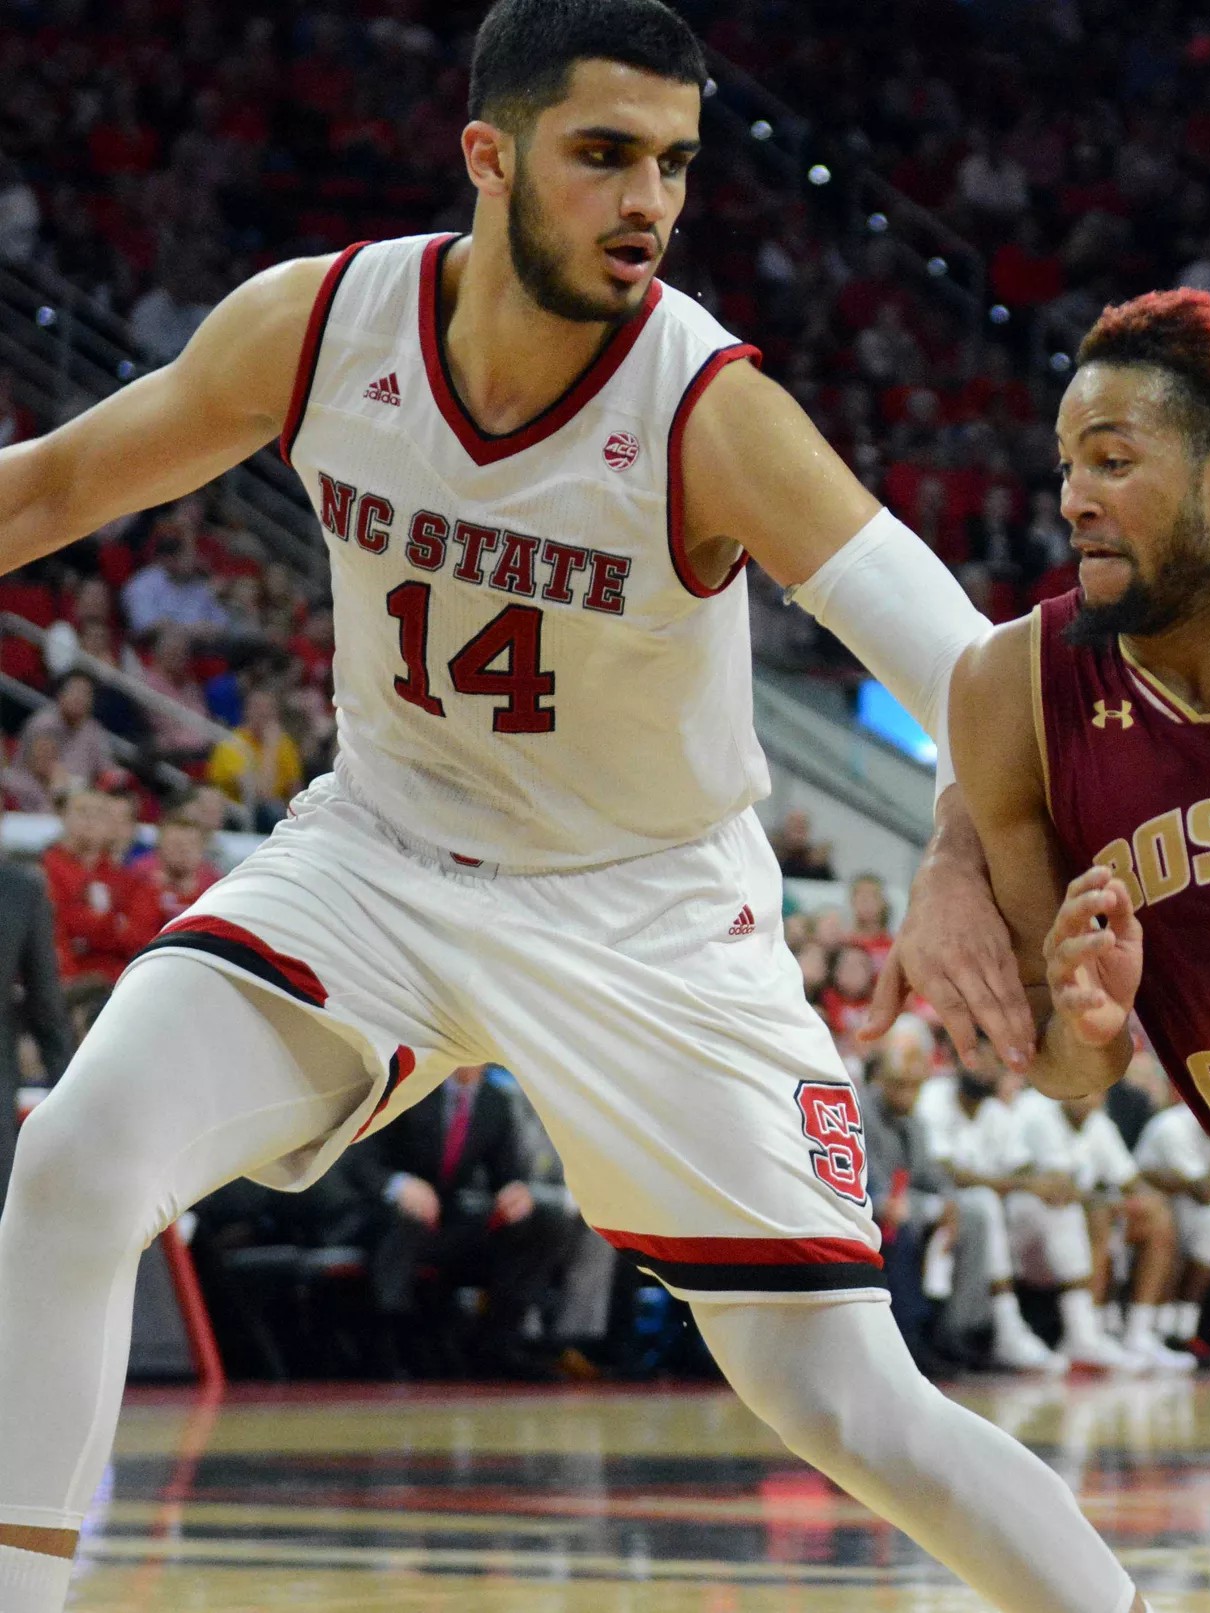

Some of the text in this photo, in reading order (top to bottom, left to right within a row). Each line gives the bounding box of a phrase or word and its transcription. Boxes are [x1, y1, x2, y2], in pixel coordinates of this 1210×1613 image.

[604, 442, 639, 457] ACC
[318, 471, 631, 614] NC STATE
[386, 580, 556, 733] 14
